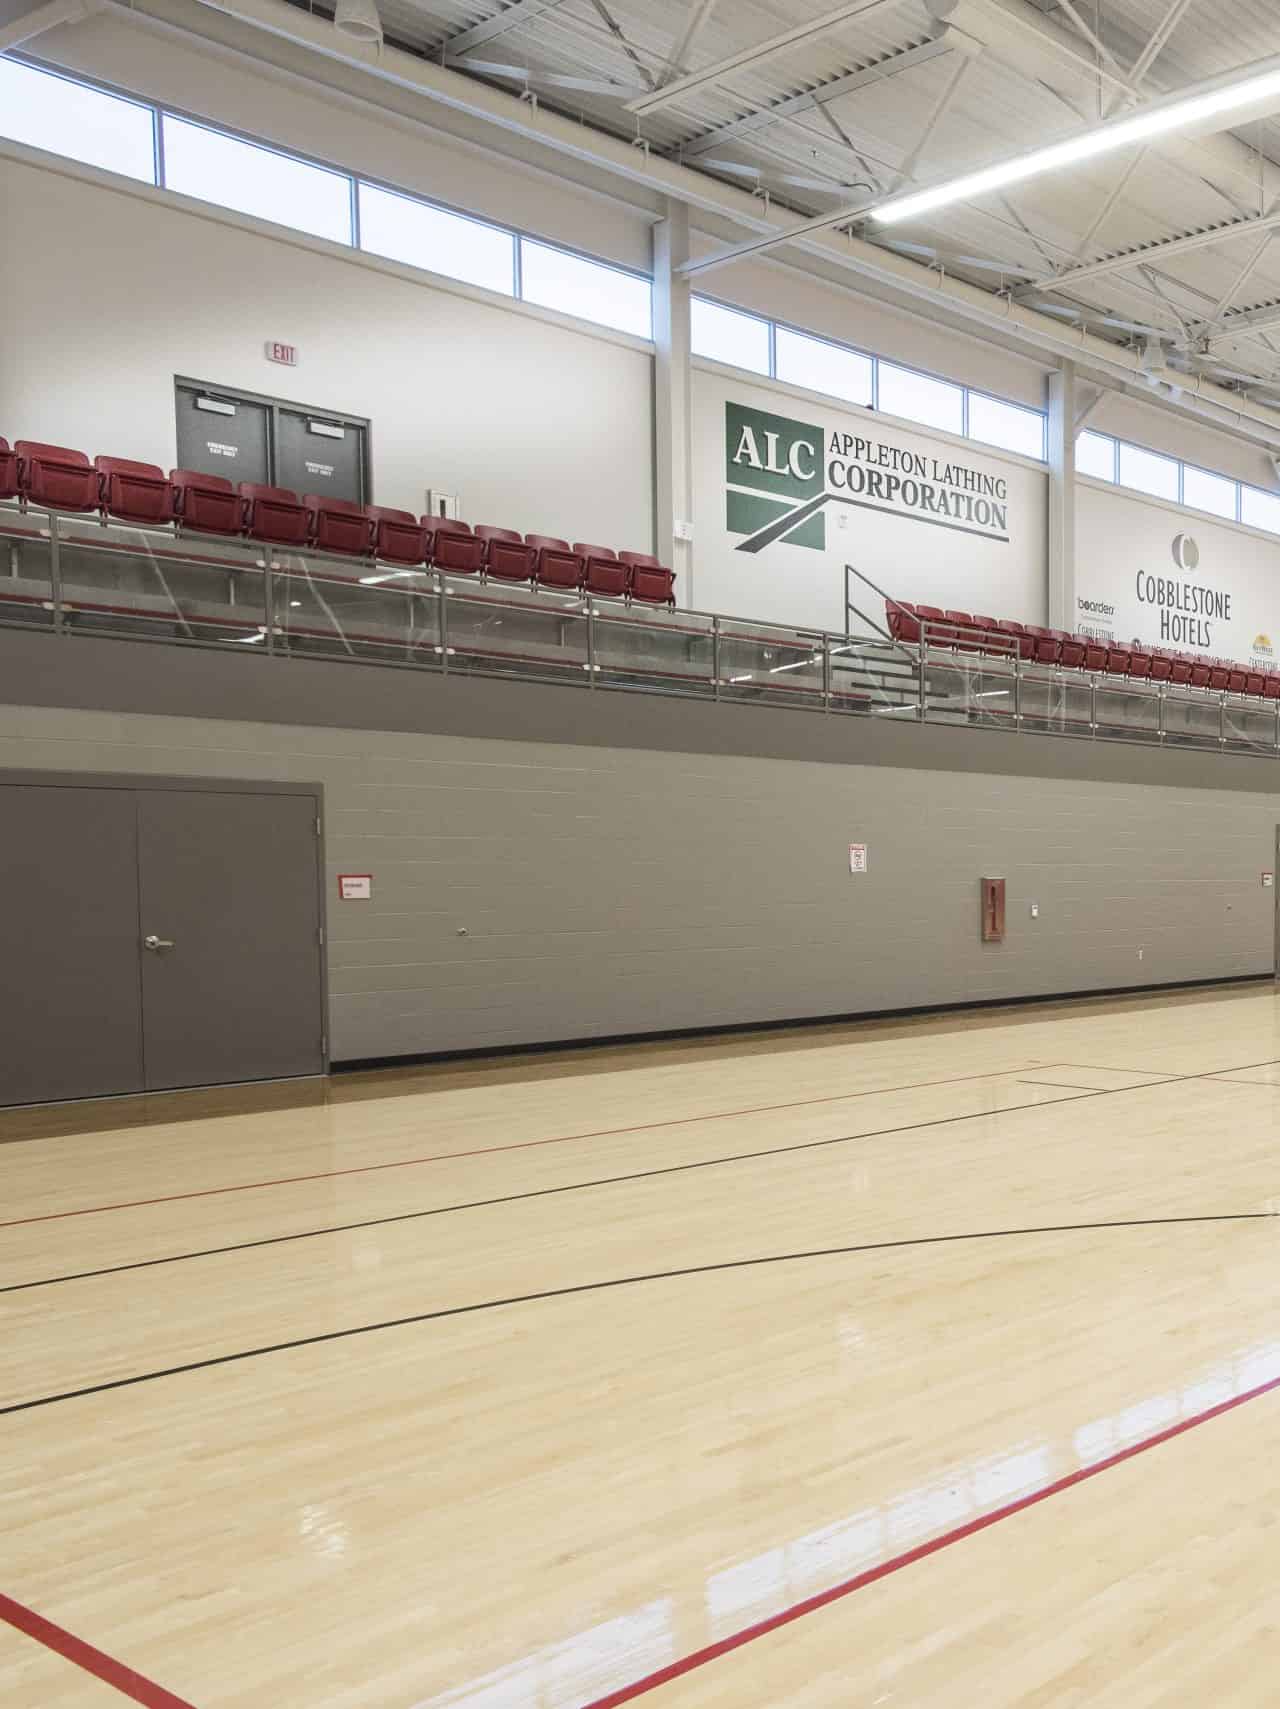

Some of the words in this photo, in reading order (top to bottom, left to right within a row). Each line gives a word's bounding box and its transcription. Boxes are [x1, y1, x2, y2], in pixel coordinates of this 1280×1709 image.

[273, 343, 294, 363] EXIT
[732, 425, 817, 481] ALC
[829, 431, 927, 478] APPLETON
[931, 459, 1007, 500] LATHING
[828, 460, 1007, 531] CORPORATION
[1136, 570, 1231, 620] COBBLESTONE
[1160, 609, 1212, 648] HOTELS
